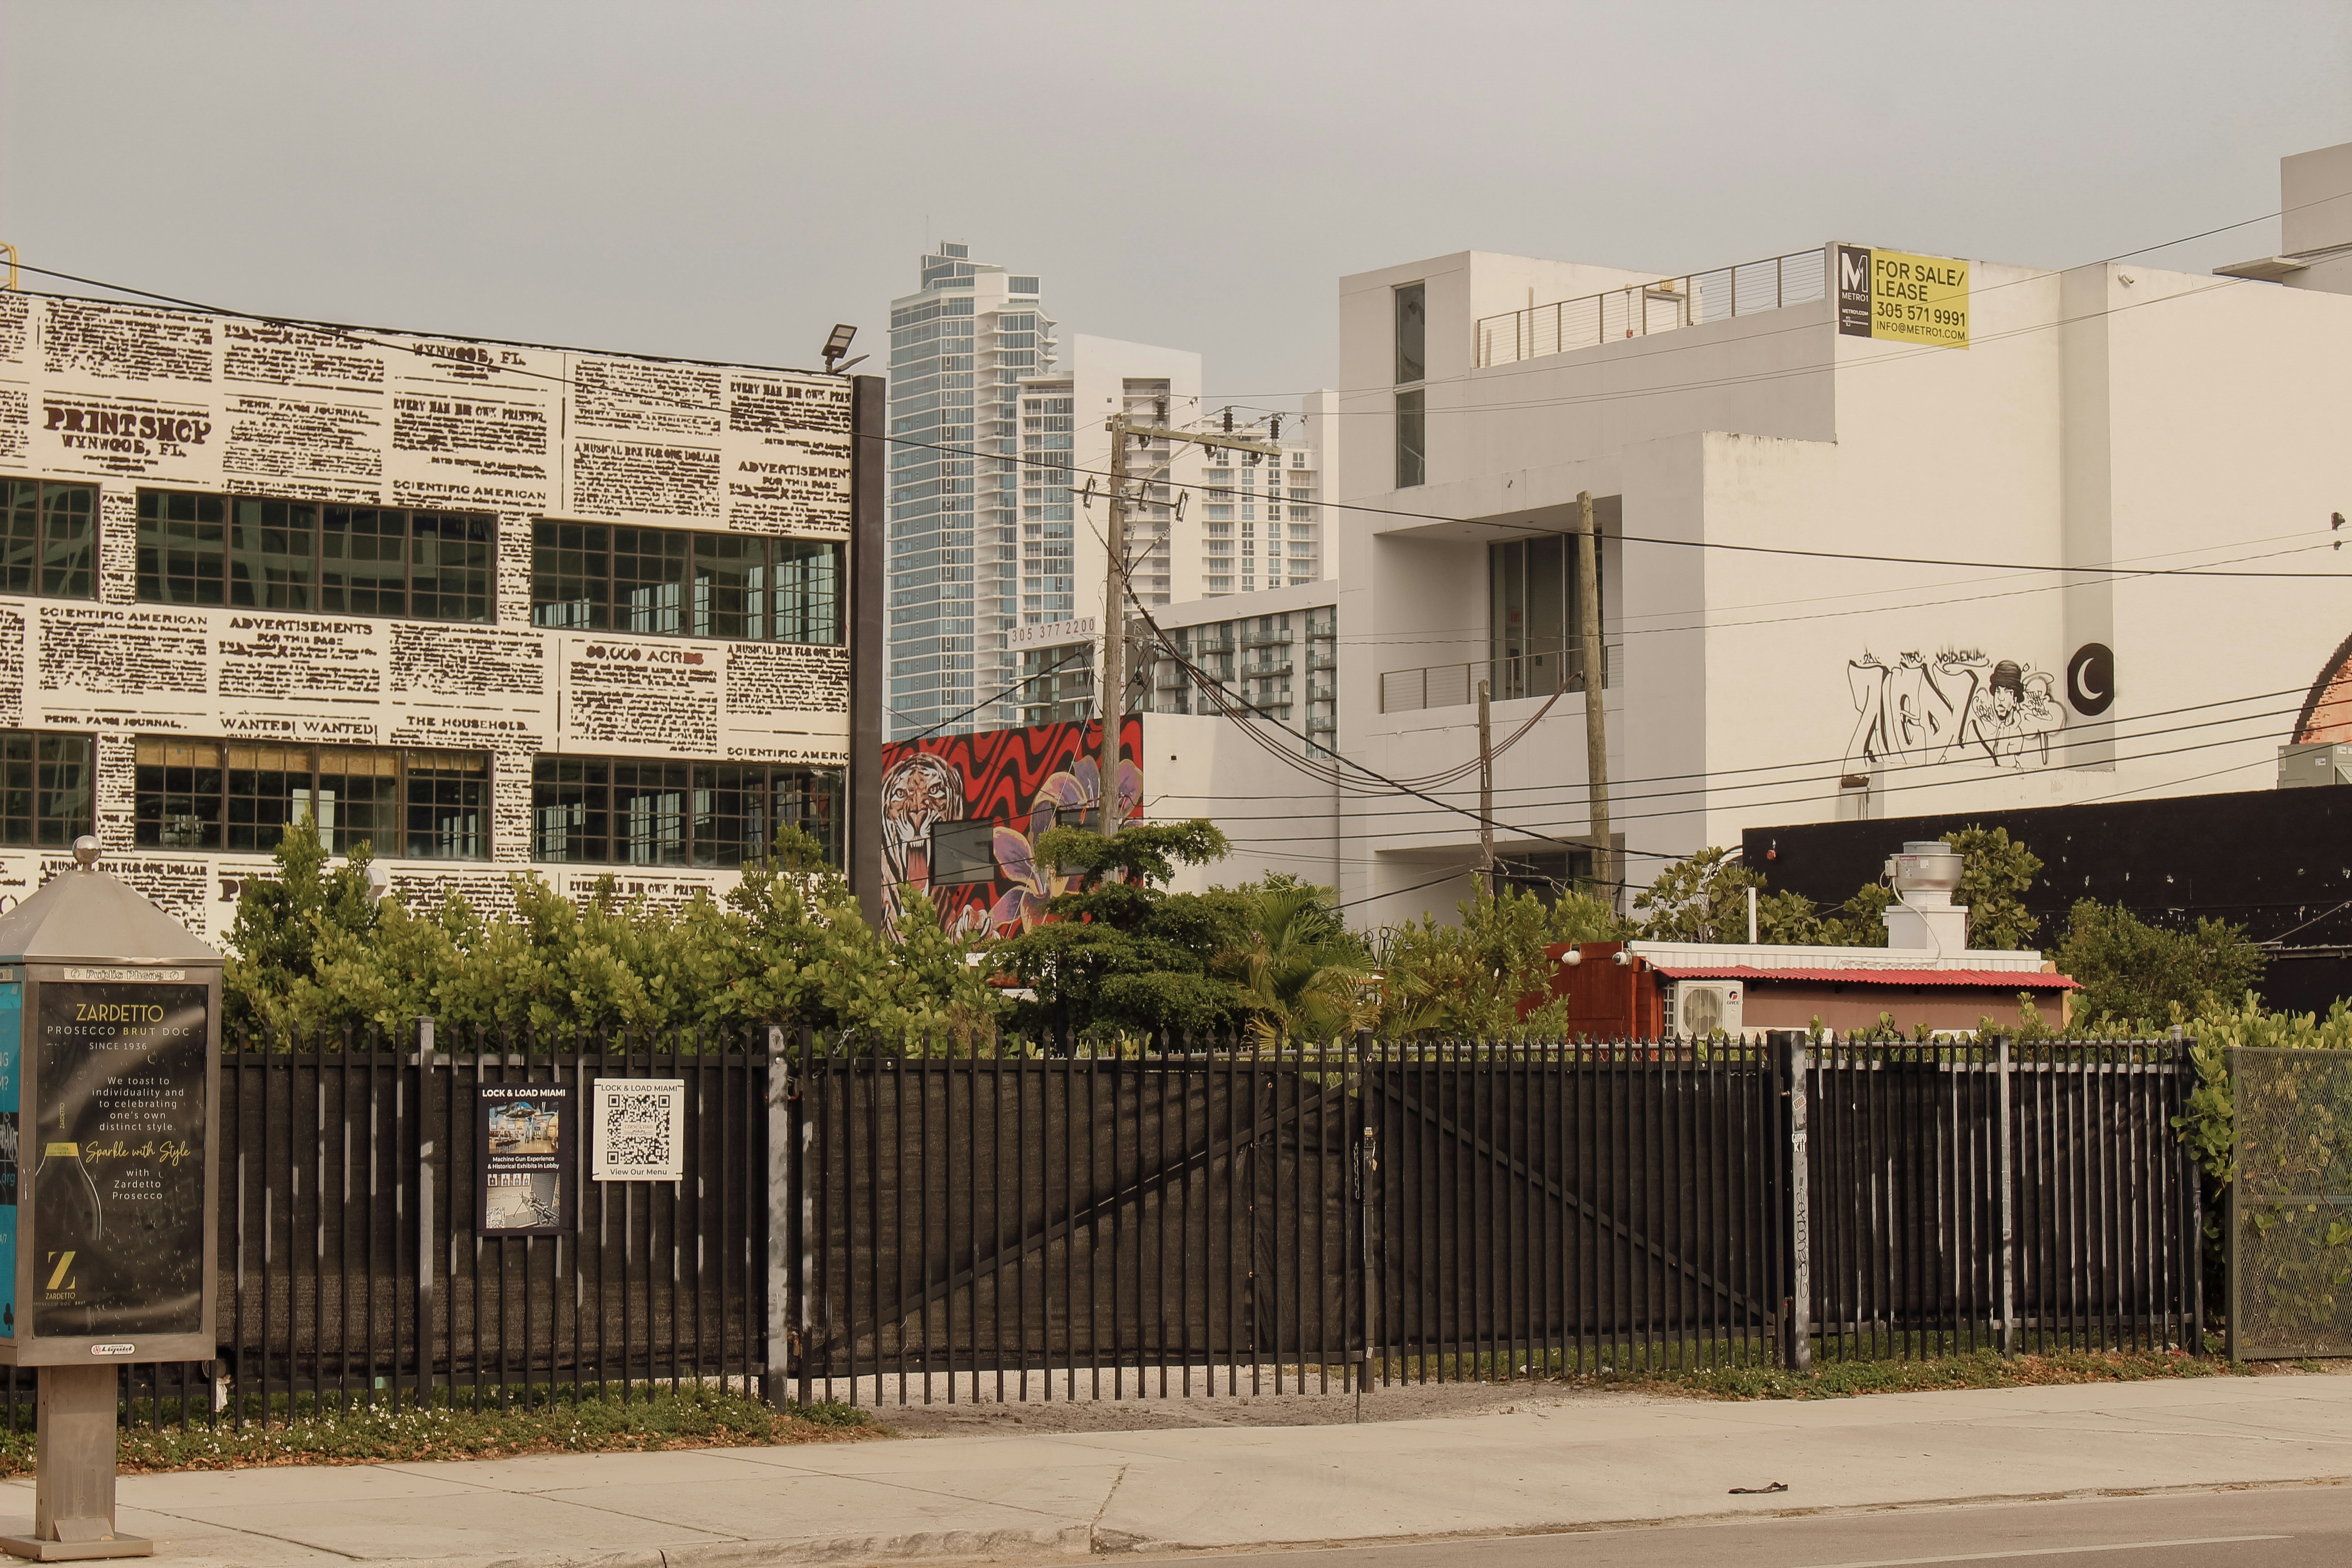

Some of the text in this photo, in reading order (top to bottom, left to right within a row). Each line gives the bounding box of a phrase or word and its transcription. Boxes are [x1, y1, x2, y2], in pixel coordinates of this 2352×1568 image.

[1876, 259, 1910, 280] FOR
[1877, 279, 1928, 302] LEASE
[1842, 292, 1869, 302] METRO1
[1877, 301, 1965, 327] 305 571 9991
[1877, 320, 1965, 340] INFO@METRO1.COM
[43, 407, 138, 436] PRINT
[139, 416, 211, 445] SHOP
[393, 480, 470, 494] SCIENTIFIC
[474, 487, 546, 500] AMERICAN
[39, 607, 208, 625] SCIENTIFIC AMERICAN
[229, 617, 373, 635] ADVERTISEMENTS
[1012, 618, 1094, 642] 305 377 2200
[647, 650, 703, 665] ACR
[407, 715, 436, 726] THE
[727, 747, 798, 758] SCIENTIFIC
[86, 970, 164, 980] Public Phone
[76, 1003, 164, 1023] ZARDETTO
[47, 1026, 190, 1036] PROSECCO BRUT DOC
[89, 1042, 147, 1050] SINCE 1936
[108, 1076, 123, 1085] We
[92, 1088, 160, 1098] individuality
[482, 1089, 566, 1098] LOCK & LOAD MIAMI
[114, 1100, 177, 1110] celebrating
[110, 1111, 139, 1119] one's
[99, 1122, 176, 1132] distinct style.
[86, 1141, 191, 1166] Sparkle with Style
[126, 1168, 149, 1177] with
[114, 1180, 161, 1189] Zardetto
[112, 1191, 163, 1200] Prosecco
